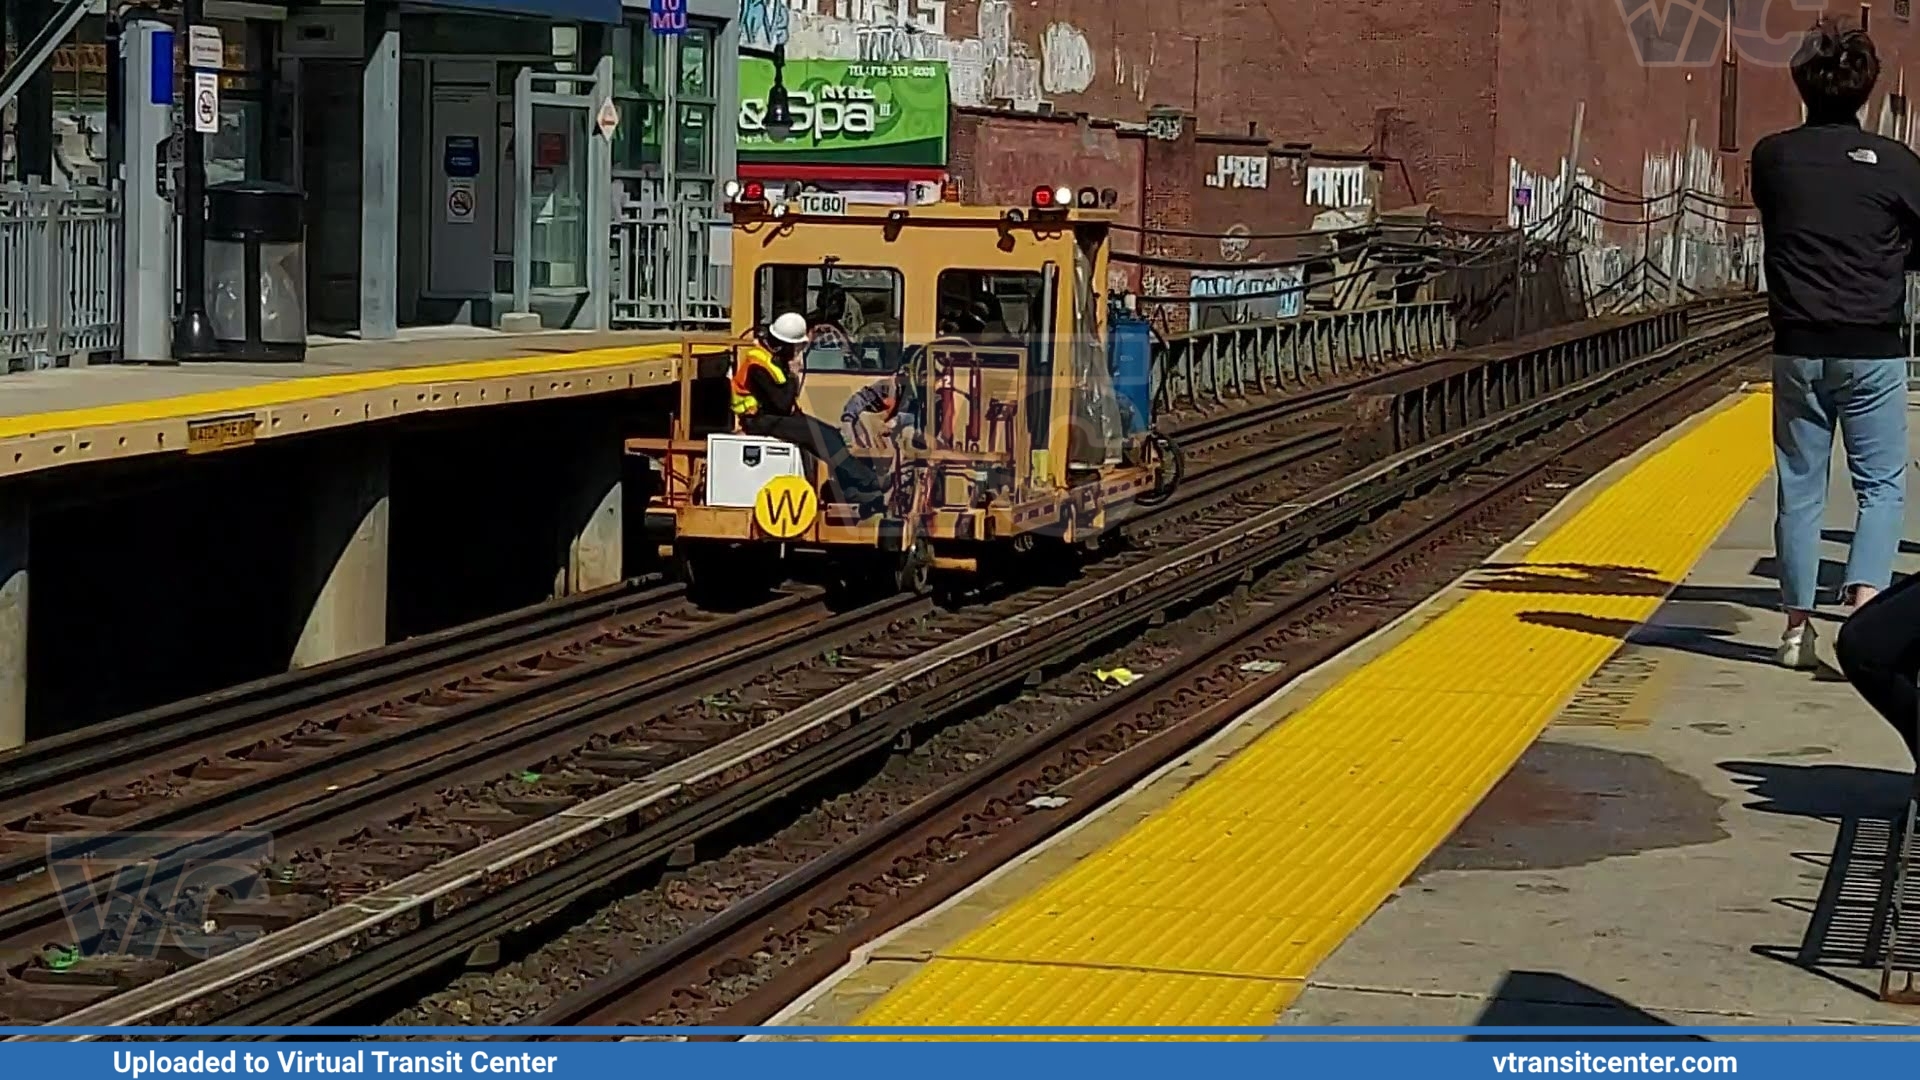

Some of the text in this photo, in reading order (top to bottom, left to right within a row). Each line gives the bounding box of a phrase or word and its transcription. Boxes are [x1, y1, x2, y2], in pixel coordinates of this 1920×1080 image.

[652, 12, 685, 29] MU
[788, 91, 875, 140] Spa
[764, 487, 809, 526] W
